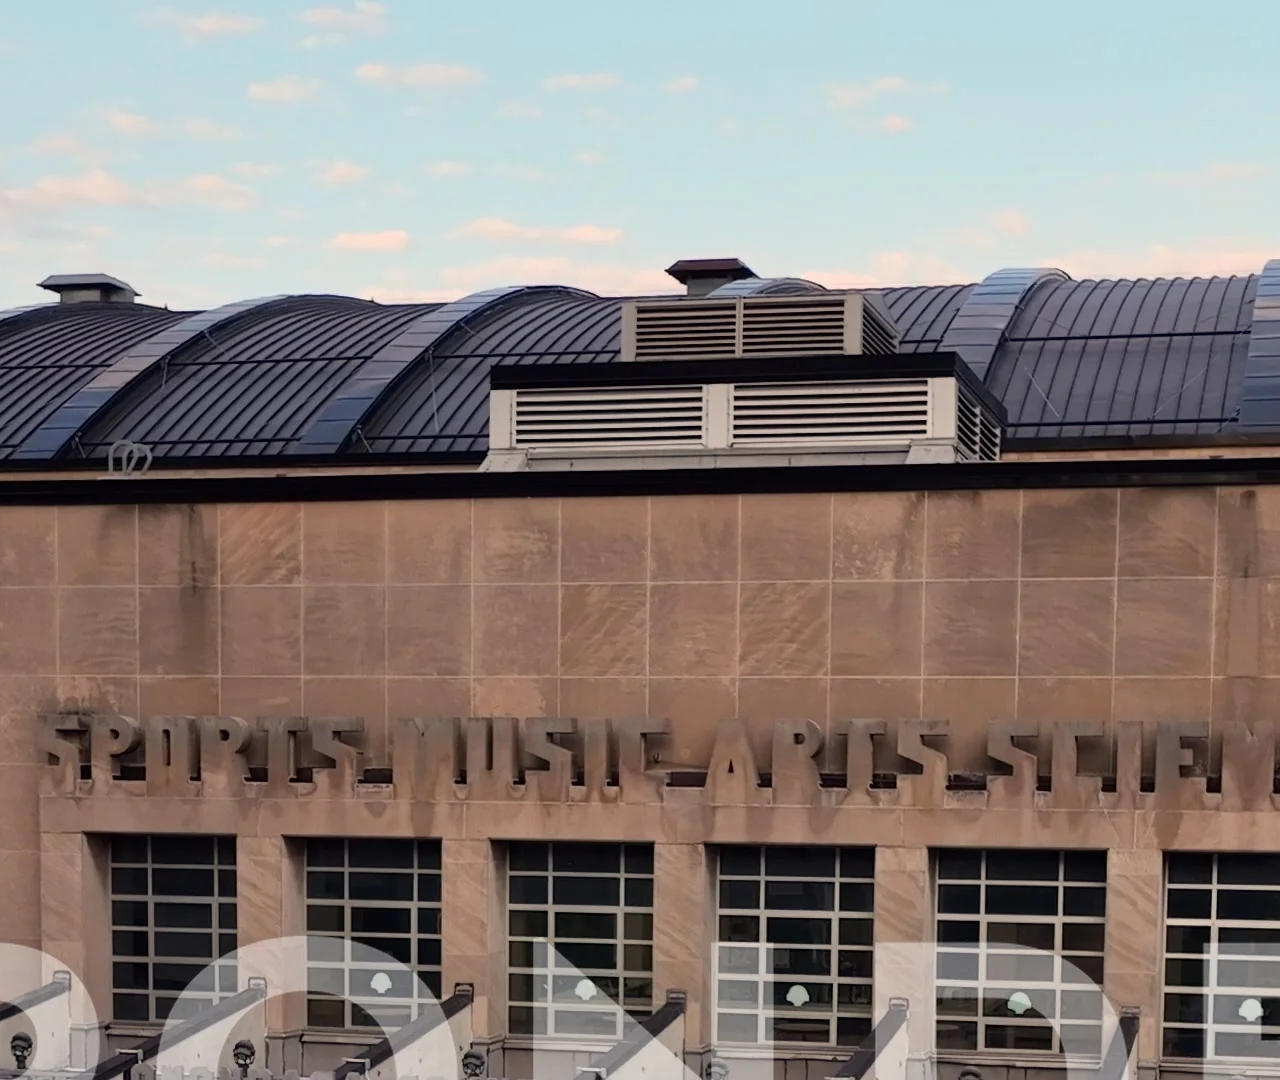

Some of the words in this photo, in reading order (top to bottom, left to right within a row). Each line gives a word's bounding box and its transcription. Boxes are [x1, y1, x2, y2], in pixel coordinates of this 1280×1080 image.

[37, 714, 369, 799] SPORTS
[392, 715, 673, 803] MUSIC
[704, 717, 951, 808] ARTS
